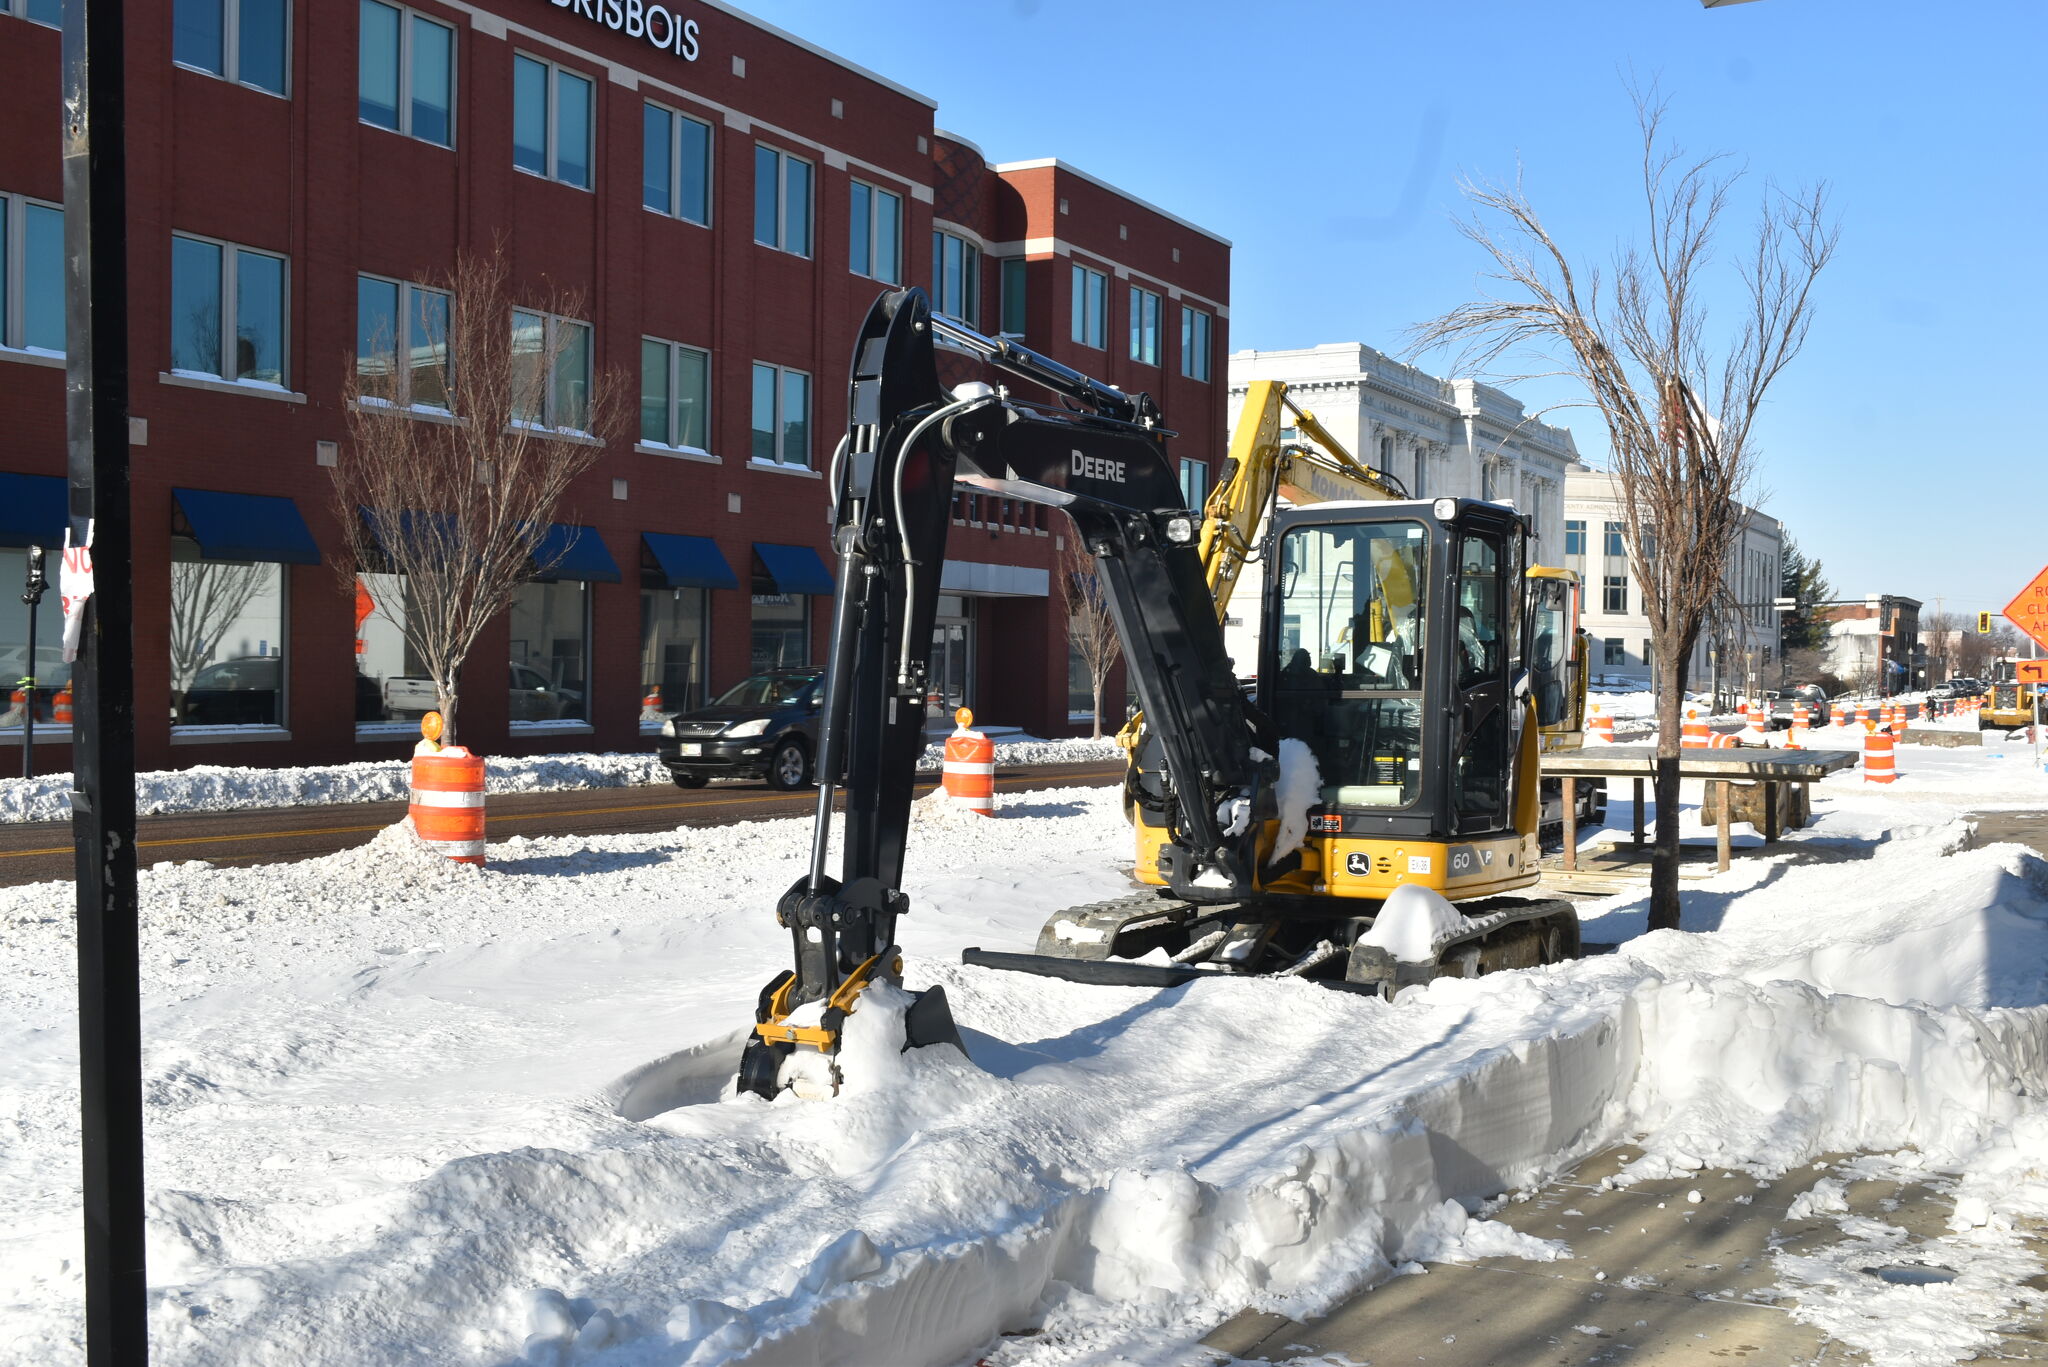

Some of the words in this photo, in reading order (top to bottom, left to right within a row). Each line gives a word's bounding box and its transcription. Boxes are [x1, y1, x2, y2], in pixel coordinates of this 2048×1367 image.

[1071, 449, 1126, 483] DEERE
[2027, 603, 2048, 615] CL
[1453, 852, 1470, 870] 60
[1485, 850, 1493, 864] P
